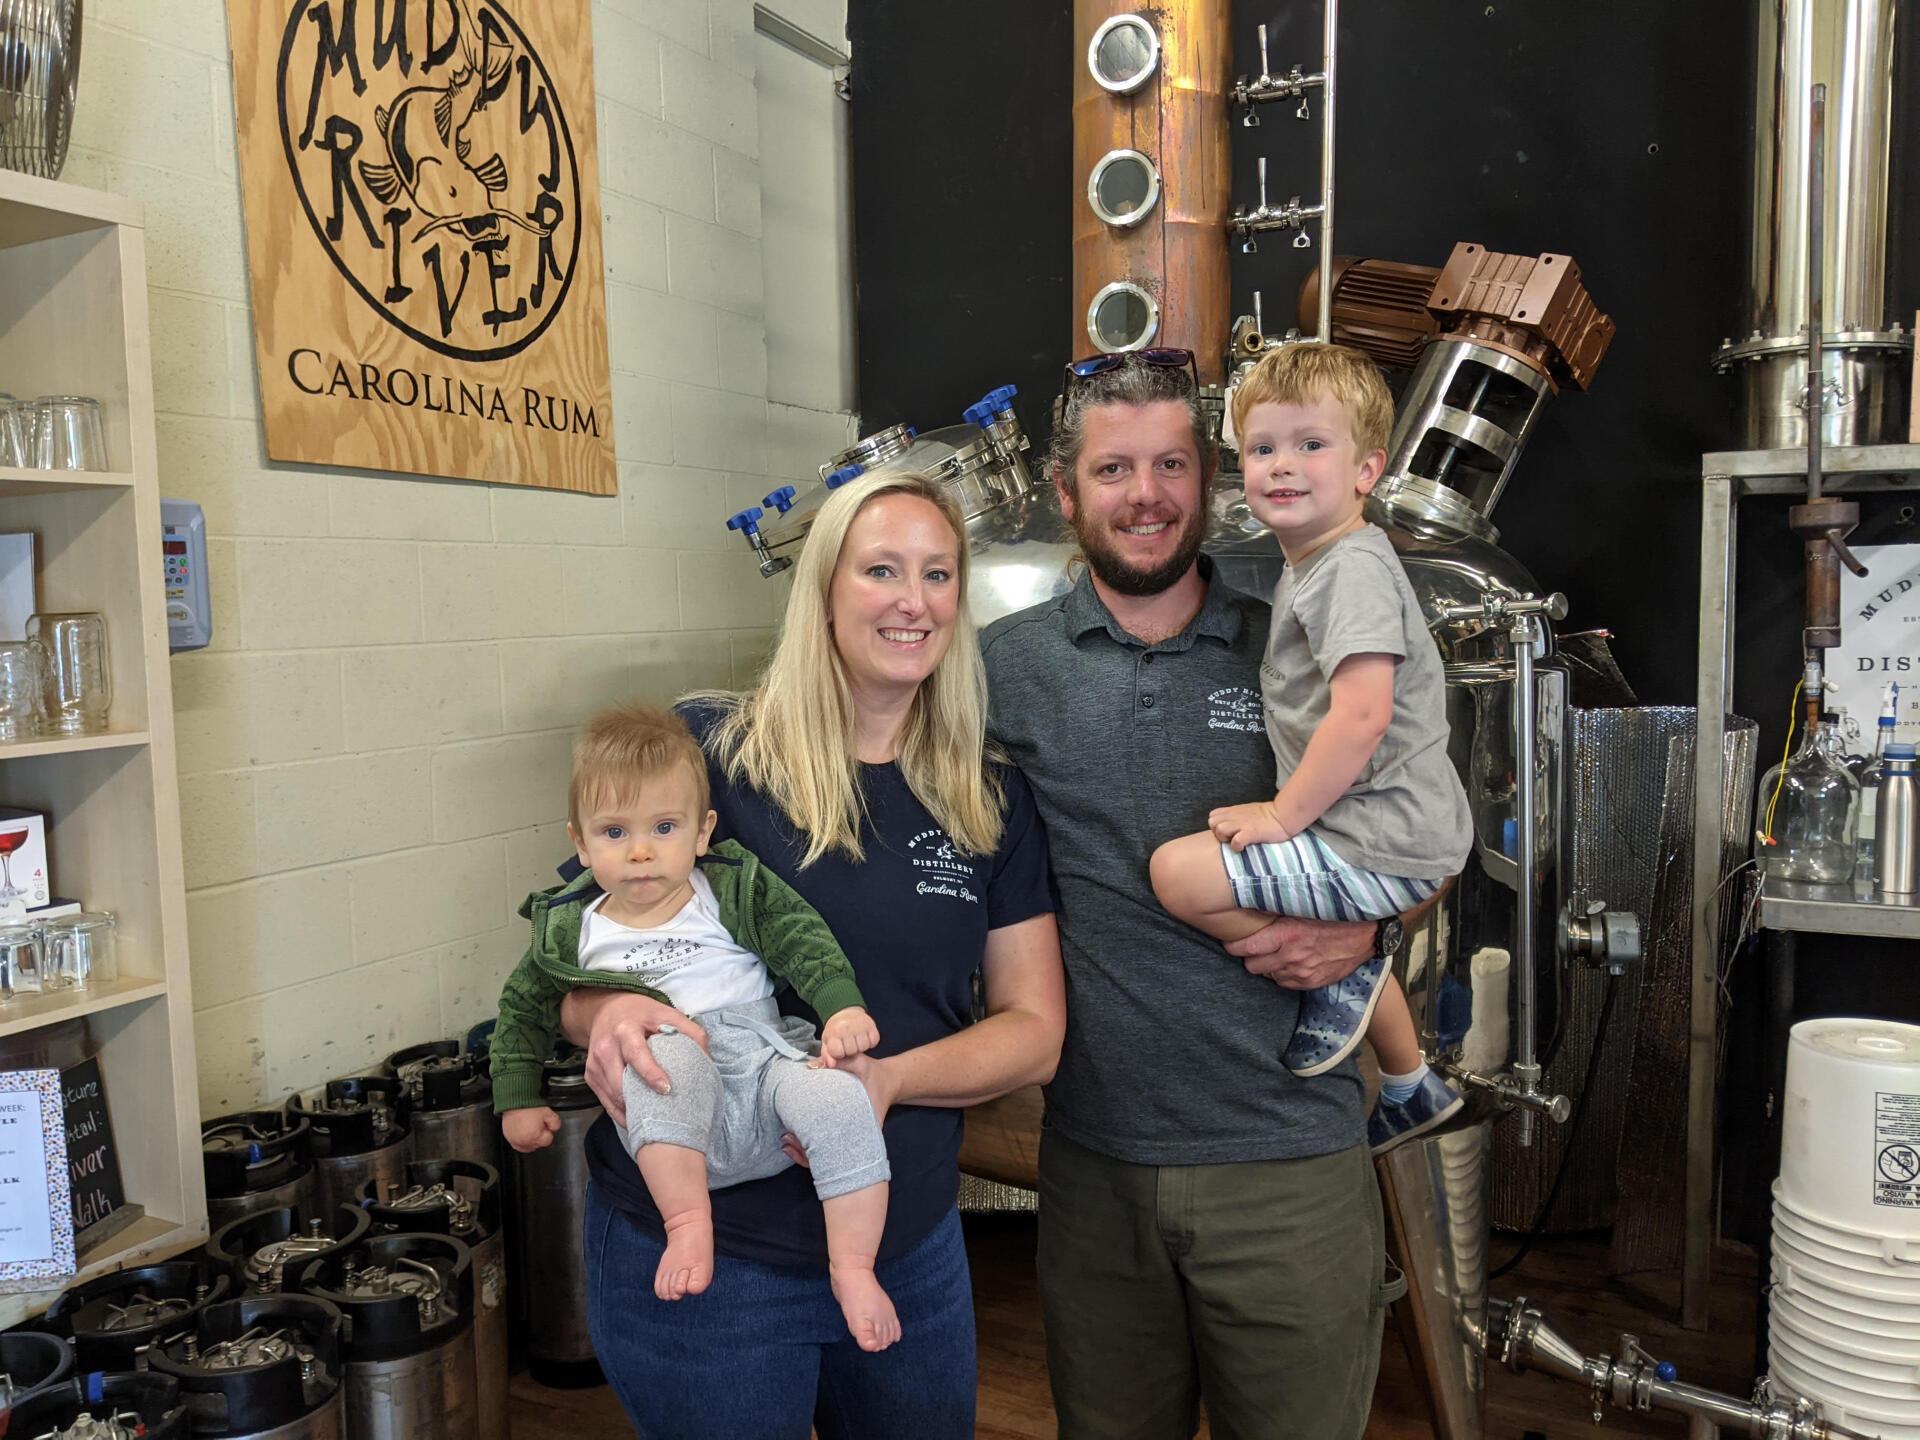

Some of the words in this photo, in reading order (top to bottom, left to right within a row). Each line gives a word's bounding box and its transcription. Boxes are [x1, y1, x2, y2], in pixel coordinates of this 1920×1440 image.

[299, 0, 561, 193] MUDDY
[314, 114, 564, 338] RIVER
[286, 348, 513, 424] CAROLINA
[521, 387, 601, 438] RUM
[1859, 572, 1920, 621] MUD
[1856, 656, 1920, 672] DIS
[1208, 688, 1238, 701] MUDDY
[1208, 718, 1245, 731] Carolina
[908, 830, 941, 848] MUDDY
[913, 859, 974, 874] DISTILLERY
[916, 881, 958, 897] Carolina
[960, 888, 978, 903] Rum
[70, 1144, 107, 1188] iver
[1876, 1196, 1913, 1206] WARNING
